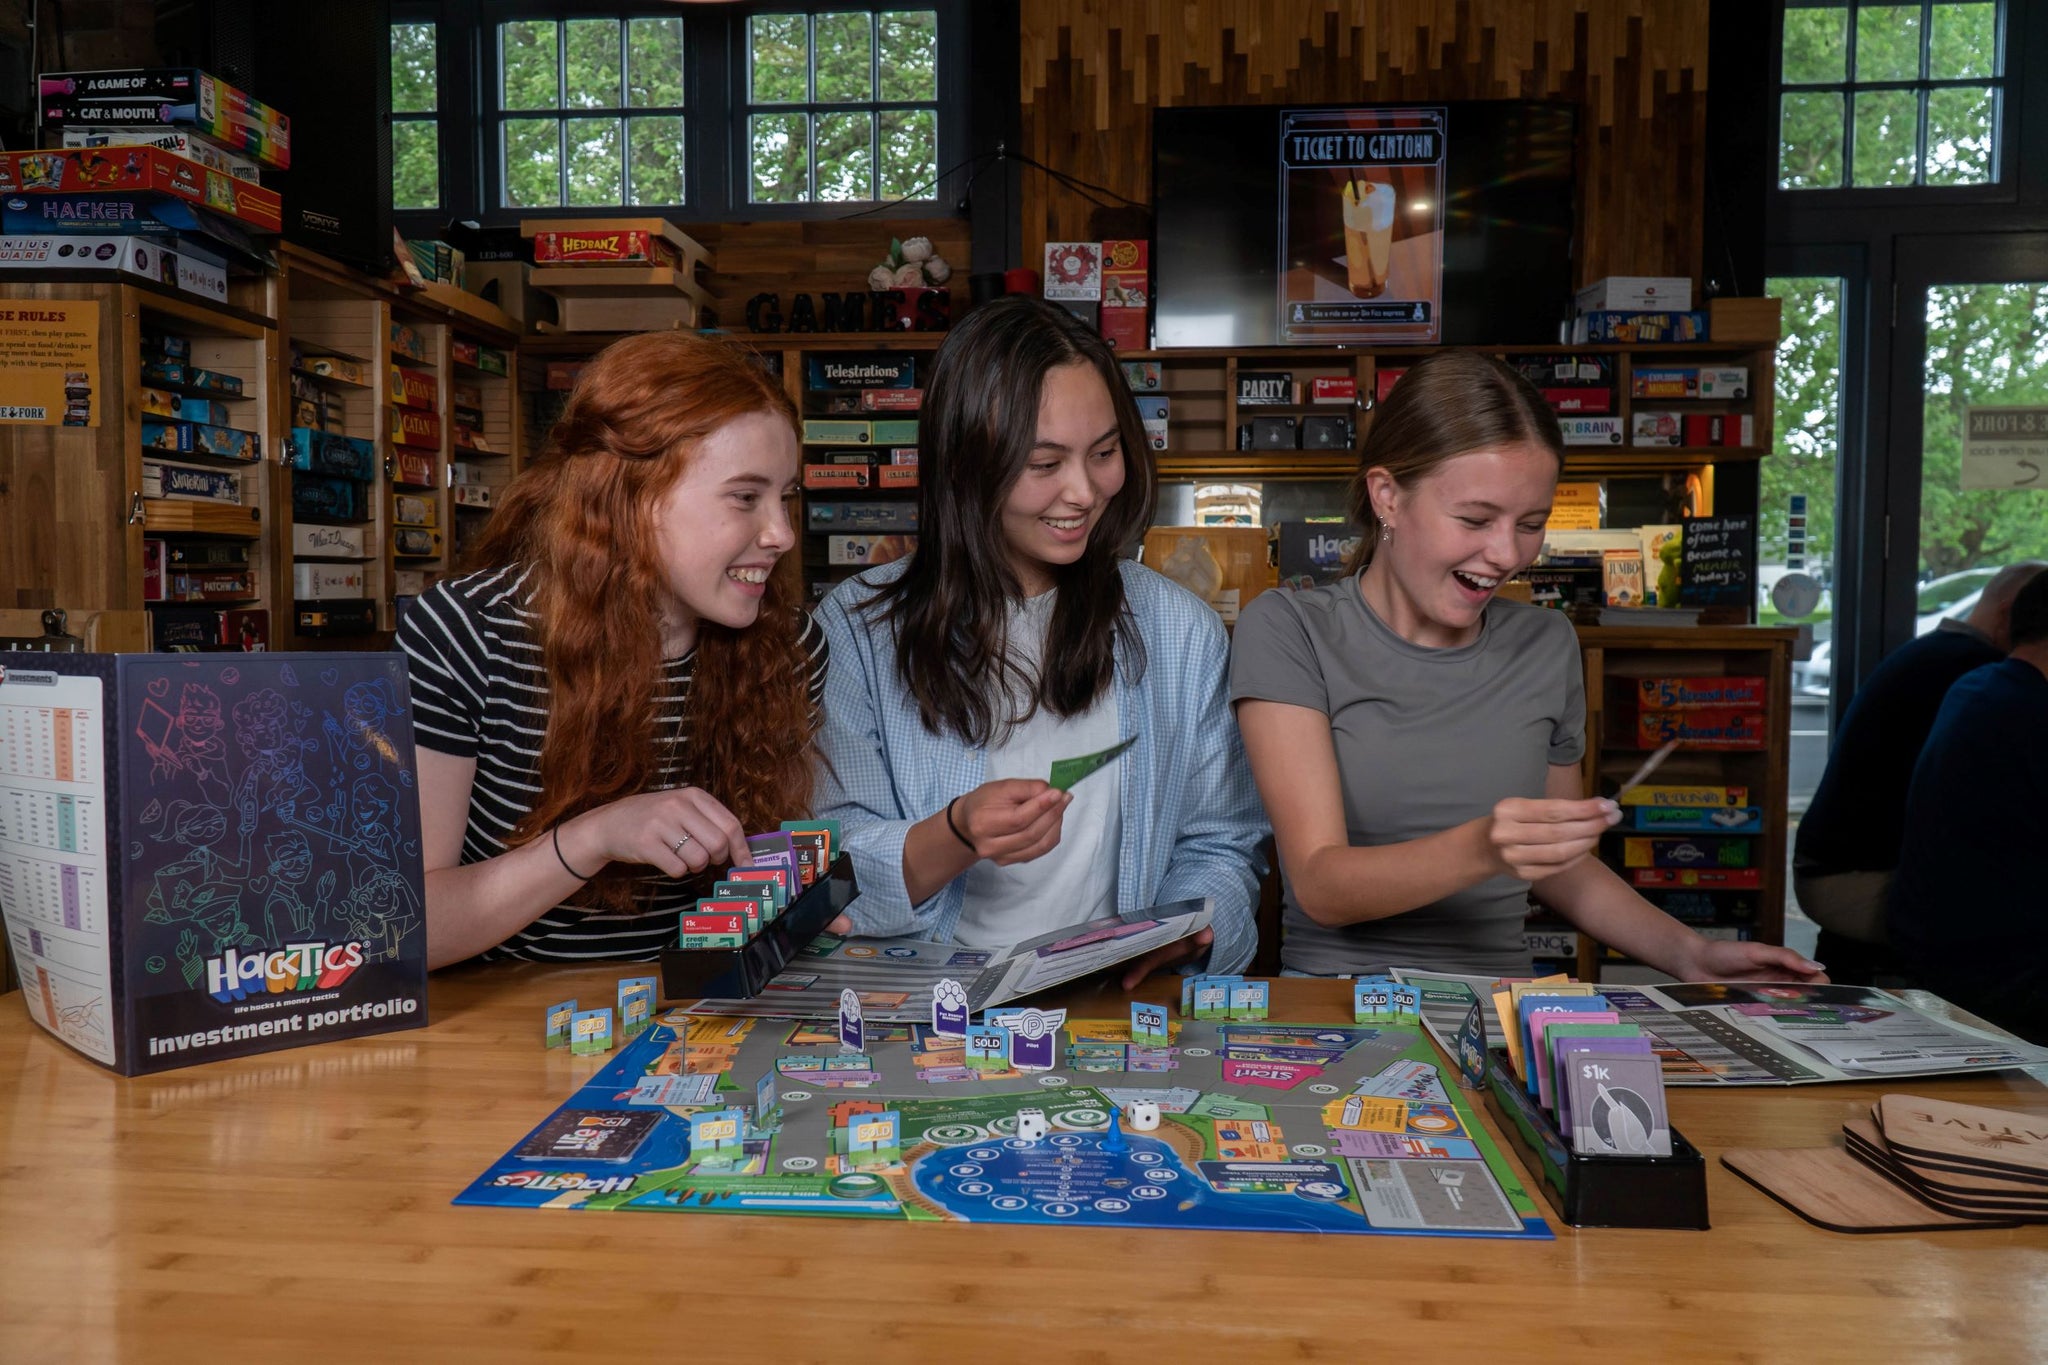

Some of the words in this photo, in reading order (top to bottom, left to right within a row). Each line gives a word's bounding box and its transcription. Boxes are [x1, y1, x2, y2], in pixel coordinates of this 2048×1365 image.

[87, 79, 97, 90] A
[97, 78, 131, 90] GAME
[131, 77, 147, 88] OF
[80, 108, 103, 119] CAT
[103, 109, 111, 119] &
[112, 108, 155, 119] MOUTH
[145, 135, 181, 151] YFALL
[177, 138, 185, 151] 2
[1293, 136, 1343, 160] TICKET
[1347, 135, 1365, 159] TO
[43, 201, 136, 220] HACKER
[302, 213, 340, 229] VONYX
[562, 235, 619, 252] HEDBANZ
[19, 311, 66, 322] RULES
[745, 290, 951, 334] GAMES
[31, 329, 47, 337] then
[48, 330, 62, 338] play
[65, 361, 86, 369] please
[825, 364, 899, 379] Telestrations
[404, 377, 429, 400] CATAN
[1242, 379, 1285, 398] PARTY
[1, 407, 7, 418] E
[18, 407, 45, 419] FORK
[402, 414, 431, 436] CATAN
[1575, 421, 1615, 434] BRAIN
[402, 453, 428, 474] CATAN
[308, 528, 328, 549] When
[334, 530, 356, 553] Dream
[1608, 561, 1639, 575] JUMBO
[1659, 682, 1677, 707] 5
[1659, 719, 1677, 742] 5
[1653, 791, 1720, 807] PICTIONARY
[753, 854, 780, 864] tments
[1529, 935, 1568, 949] ENCE
[234, 1004, 249, 1014] life
[250, 1001, 275, 1012] hacks
[276, 999, 282, 1008] &
[283, 997, 311, 1008] money
[312, 992, 340, 1002] tactics
[1202, 991, 1224, 1001] SOLD
[1239, 991, 1262, 1001] SOLD
[1363, 995, 1387, 1005] SOLD
[149, 1013, 302, 1056] investment
[308, 998, 418, 1031] portfolio
[579, 1018, 605, 1032] SOLD
[1138, 1014, 1160, 1026] SOLD
[974, 1037, 1000, 1049] SOLD
[1583, 1063, 1611, 1081] $1K
[702, 1123, 735, 1138] SOLD
[860, 1124, 892, 1139] SOLD
[1149, 1171, 1172, 1179] 10
[492, 1174, 636, 1194] HackTics
[1140, 1188, 1160, 1196] 11
[1055, 1205, 1067, 1213] 1
[1100, 1201, 1123, 1209] 12
